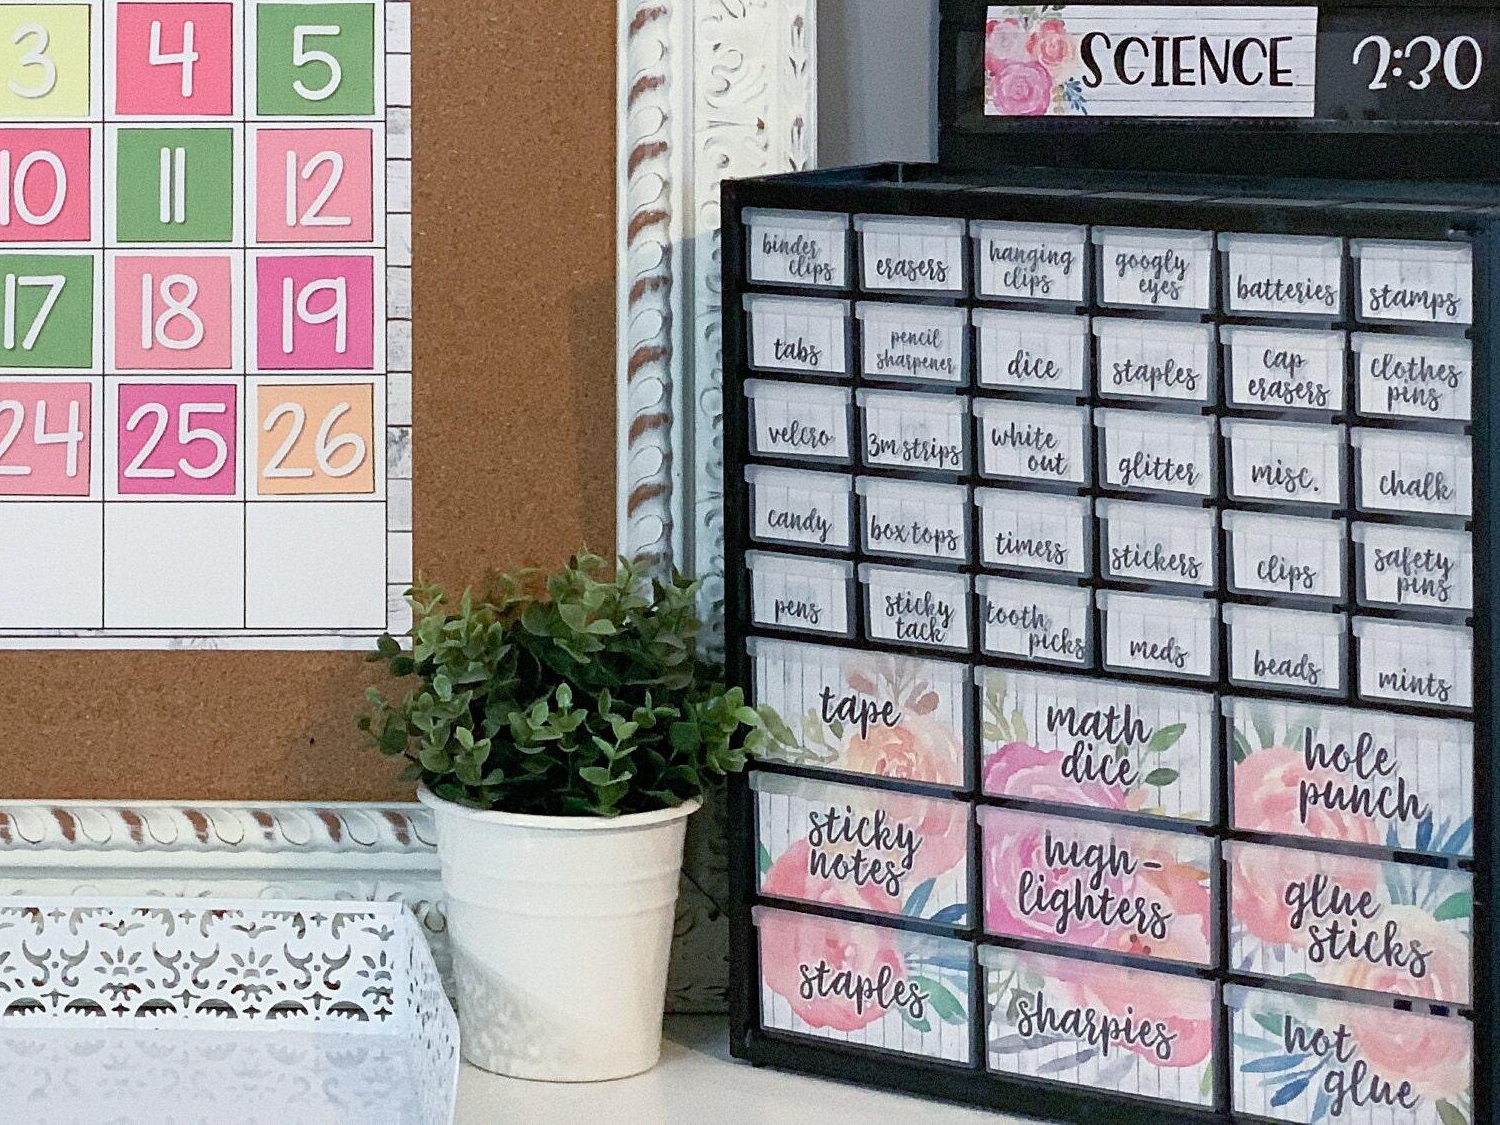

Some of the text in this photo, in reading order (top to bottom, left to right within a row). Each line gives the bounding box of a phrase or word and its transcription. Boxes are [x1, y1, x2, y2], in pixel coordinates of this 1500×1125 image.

[8, 22, 57, 98] 3
[149, 20, 198, 97] 4
[292, 24, 342, 100] 5
[1080, 32, 1483, 90] SCIENCE 2:30
[0, 149, 67, 226] 10
[159, 147, 185, 224] 11
[286, 150, 352, 226] 12
[762, 233, 822, 256] binder
[989, 240, 1076, 274] hanging
[788, 255, 836, 282] clips
[876, 258, 949, 282] erasers
[1115, 249, 1189, 280] googly
[1004, 270, 1054, 296] clips
[1139, 277, 1183, 304] eyes
[1237, 275, 1337, 306] batteries
[3, 273, 66, 350] 17
[141, 273, 204, 350] 18
[282, 276, 346, 354] 19
[1369, 283, 1460, 319] stamps
[773, 337, 822, 365] tabs
[891, 329, 942, 348] pencil
[876, 350, 954, 374] sharpener
[1007, 350, 1059, 378] dice
[1112, 360, 1199, 391] staples
[1262, 348, 1306, 377] cap
[1371, 353, 1462, 388] clothes
[1248, 379, 1330, 406] erasers
[1388, 379, 1443, 412] pins
[124, 402, 227, 478] 25
[262, 402, 366, 477] 26
[768, 421, 832, 447] velcro
[991, 423, 1058, 449] white
[1028, 455, 1067, 475] out
[1119, 451, 1199, 486] glitter
[1252, 459, 1320, 493] misc.
[1380, 470, 1453, 501] chalk
[768, 508, 832, 543] candy
[996, 532, 1067, 565] timers
[1112, 544, 1202, 578] stickers
[1374, 547, 1454, 582] safety
[1257, 555, 1316, 591] clips
[1397, 576, 1452, 603] pins
[775, 598, 822, 623] pens
[885, 591, 954, 627] sticky
[987, 601, 1051, 631] tooth
[896, 621, 946, 643] tack
[1029, 628, 1085, 660] picks
[1130, 637, 1188, 666] meds
[1255, 649, 1321, 685] beads
[1379, 668, 1451, 701] mints
[820, 687, 900, 739] tape
[1047, 704, 1152, 745] math
[1061, 741, 1139, 787] dice
[1305, 727, 1398, 779] hole
[1300, 776, 1428, 822] punch
[808, 806, 922, 870] sticky
[810, 847, 905, 897] notes
[1018, 865, 1171, 939] lighters
[1285, 874, 1380, 928] glue
[1308, 919, 1433, 978] sticks
[799, 960, 929, 1019] staples
[1017, 992, 1176, 1060] sharpies
[1285, 1014, 1356, 1063] hot
[1324, 1059, 1419, 1118] glue
